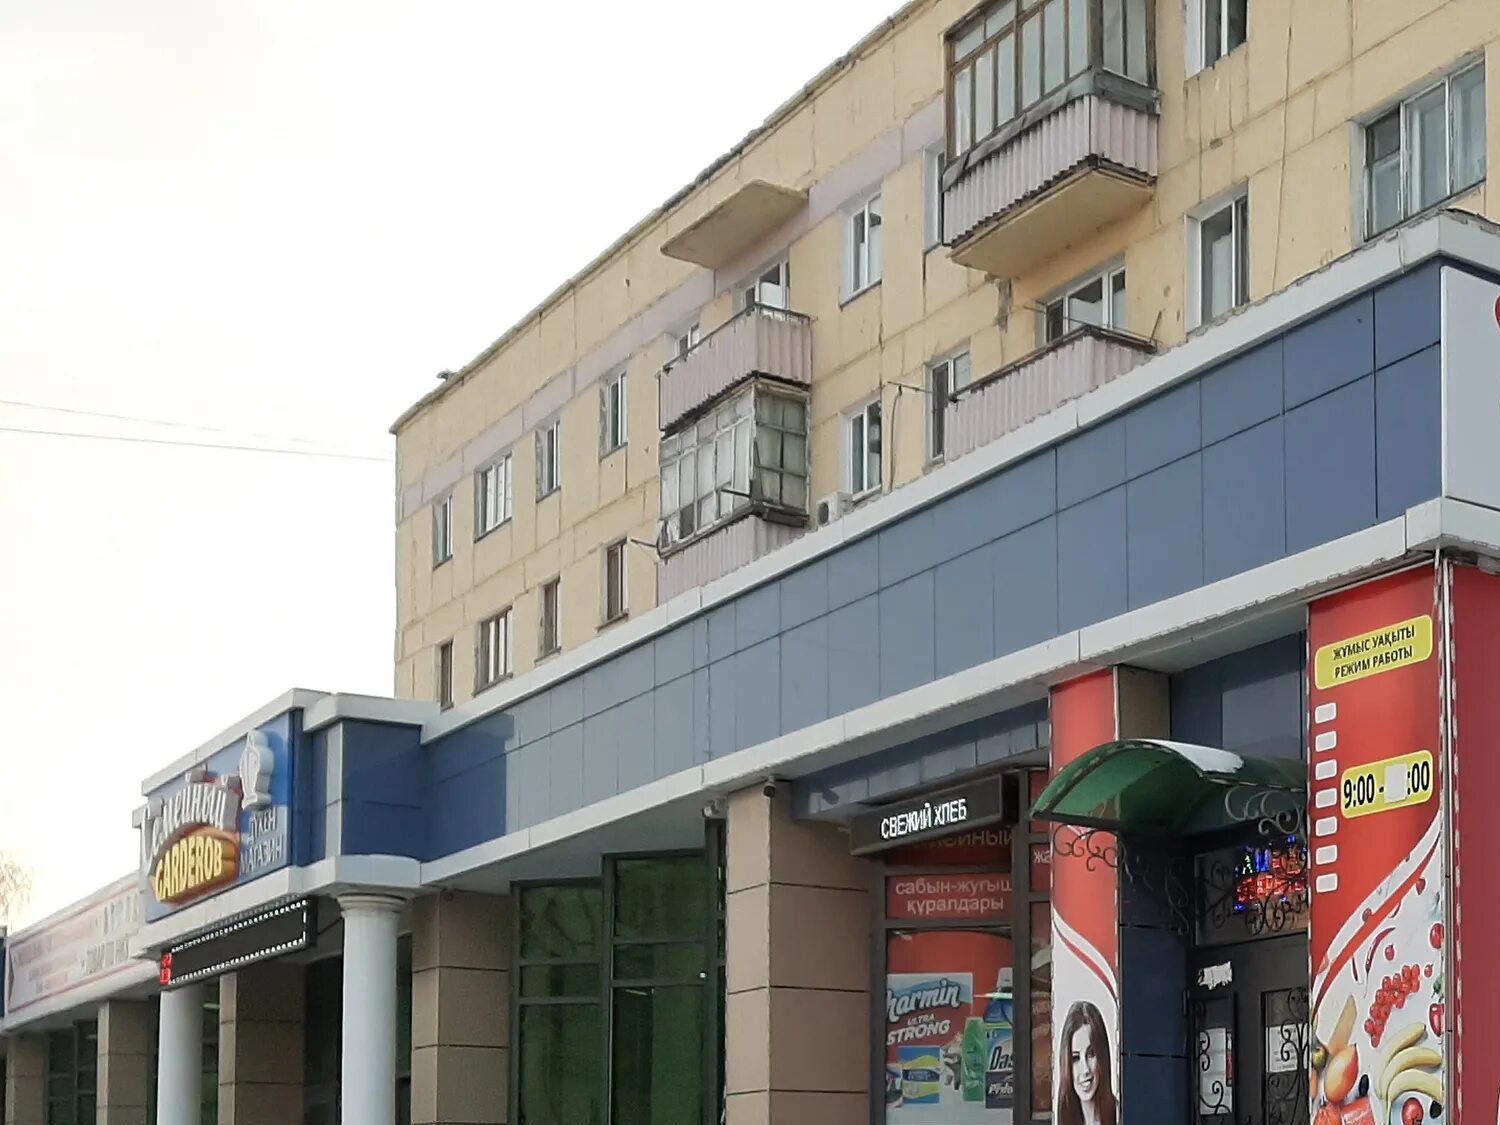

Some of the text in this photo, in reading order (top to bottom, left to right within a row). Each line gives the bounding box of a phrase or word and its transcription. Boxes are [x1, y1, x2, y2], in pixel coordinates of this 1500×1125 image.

[1372, 624, 1415, 651] УАҚЫТЫ
[1334, 645, 1414, 679] РЕЖИМ РАБОТЫ
[1343, 773, 1375, 809] 9:00
[881, 799, 968, 839] СВЕЖИЙ ХЛЕБ
[155, 835, 223, 900] GARDEROB
[886, 1020, 951, 1046] STRONG
